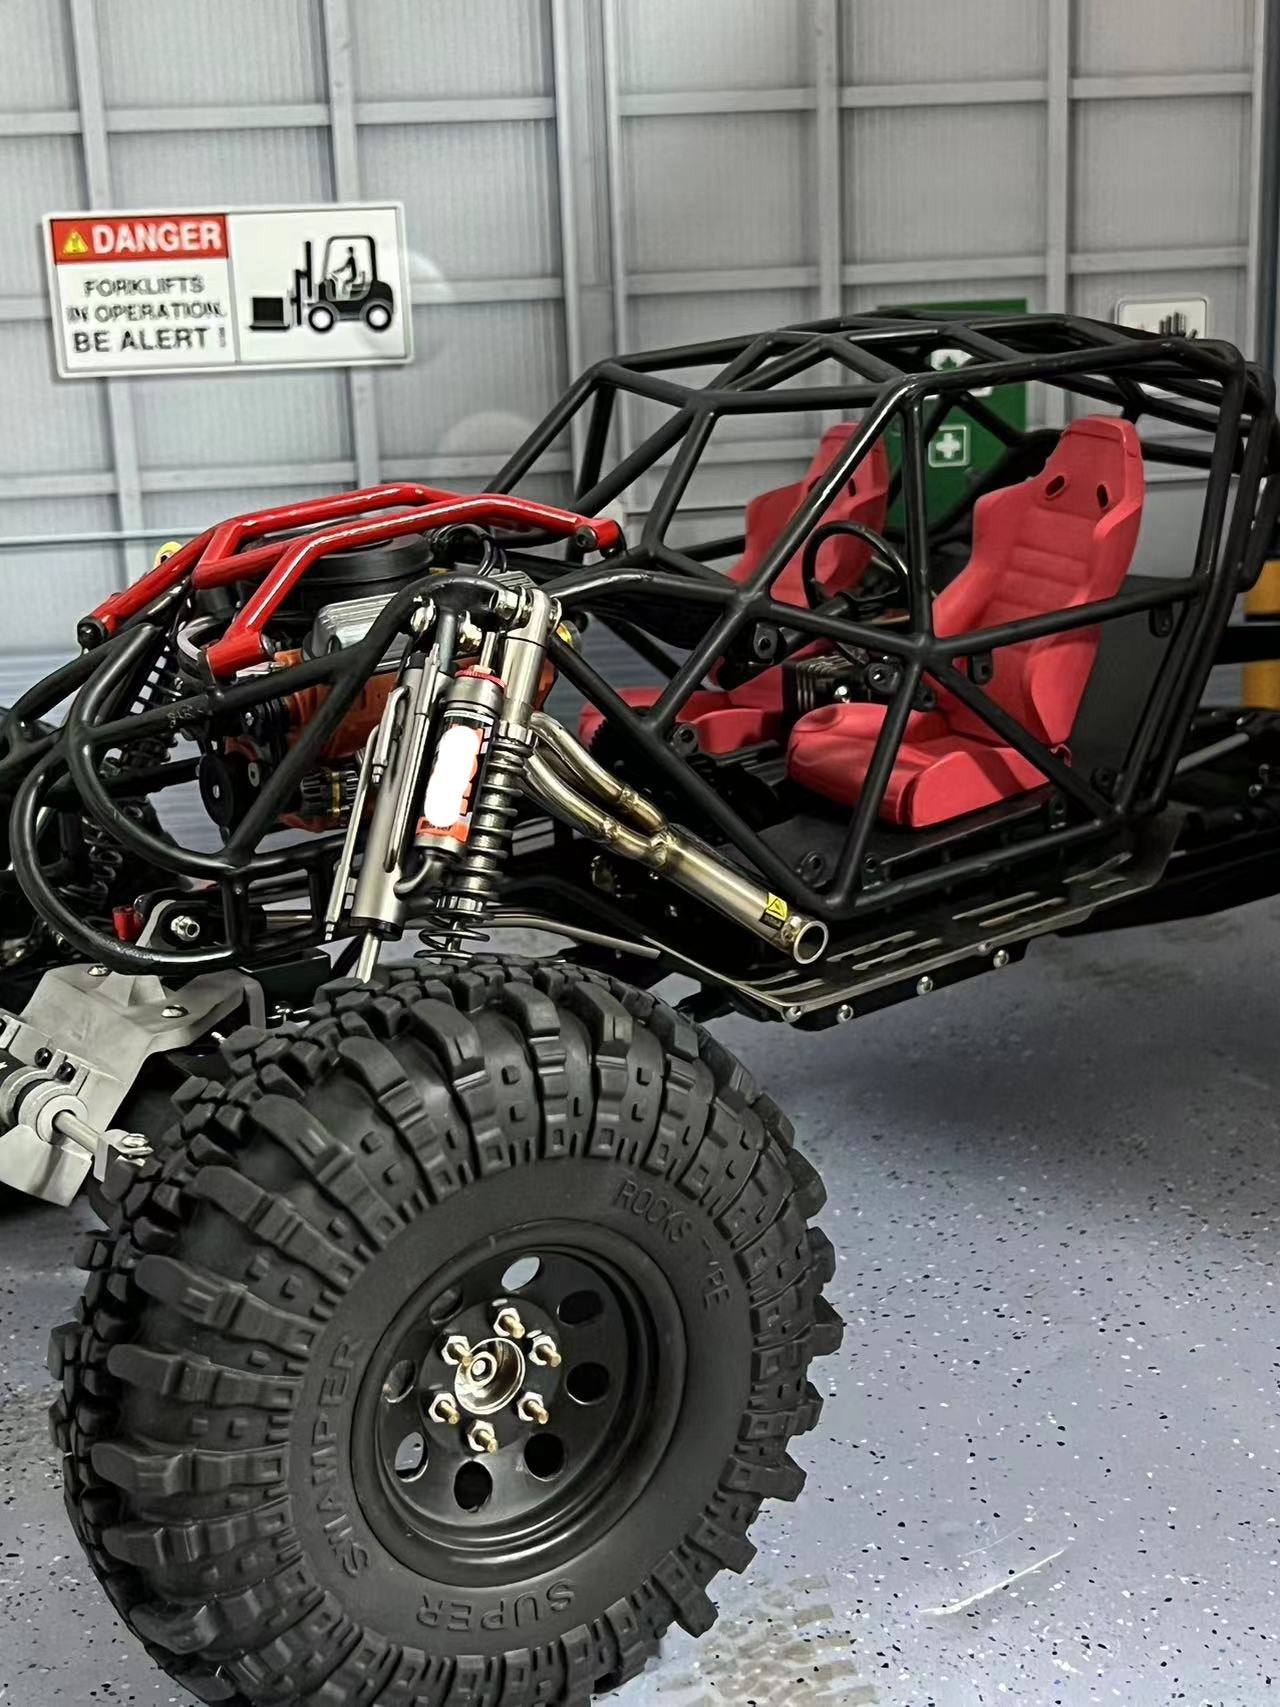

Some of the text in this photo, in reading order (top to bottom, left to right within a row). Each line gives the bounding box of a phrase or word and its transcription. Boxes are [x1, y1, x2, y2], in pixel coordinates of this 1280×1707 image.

[91, 221, 222, 254] DANGER
[84, 275, 205, 297] FORKLIFTS
[94, 302, 226, 322] OPERATION
[74, 331, 110, 352] BE
[121, 327, 209, 351] ALERT
[612, 1178, 693, 1243] ROCKS
[311, 1334, 577, 1632] SUPER SWAMPER
